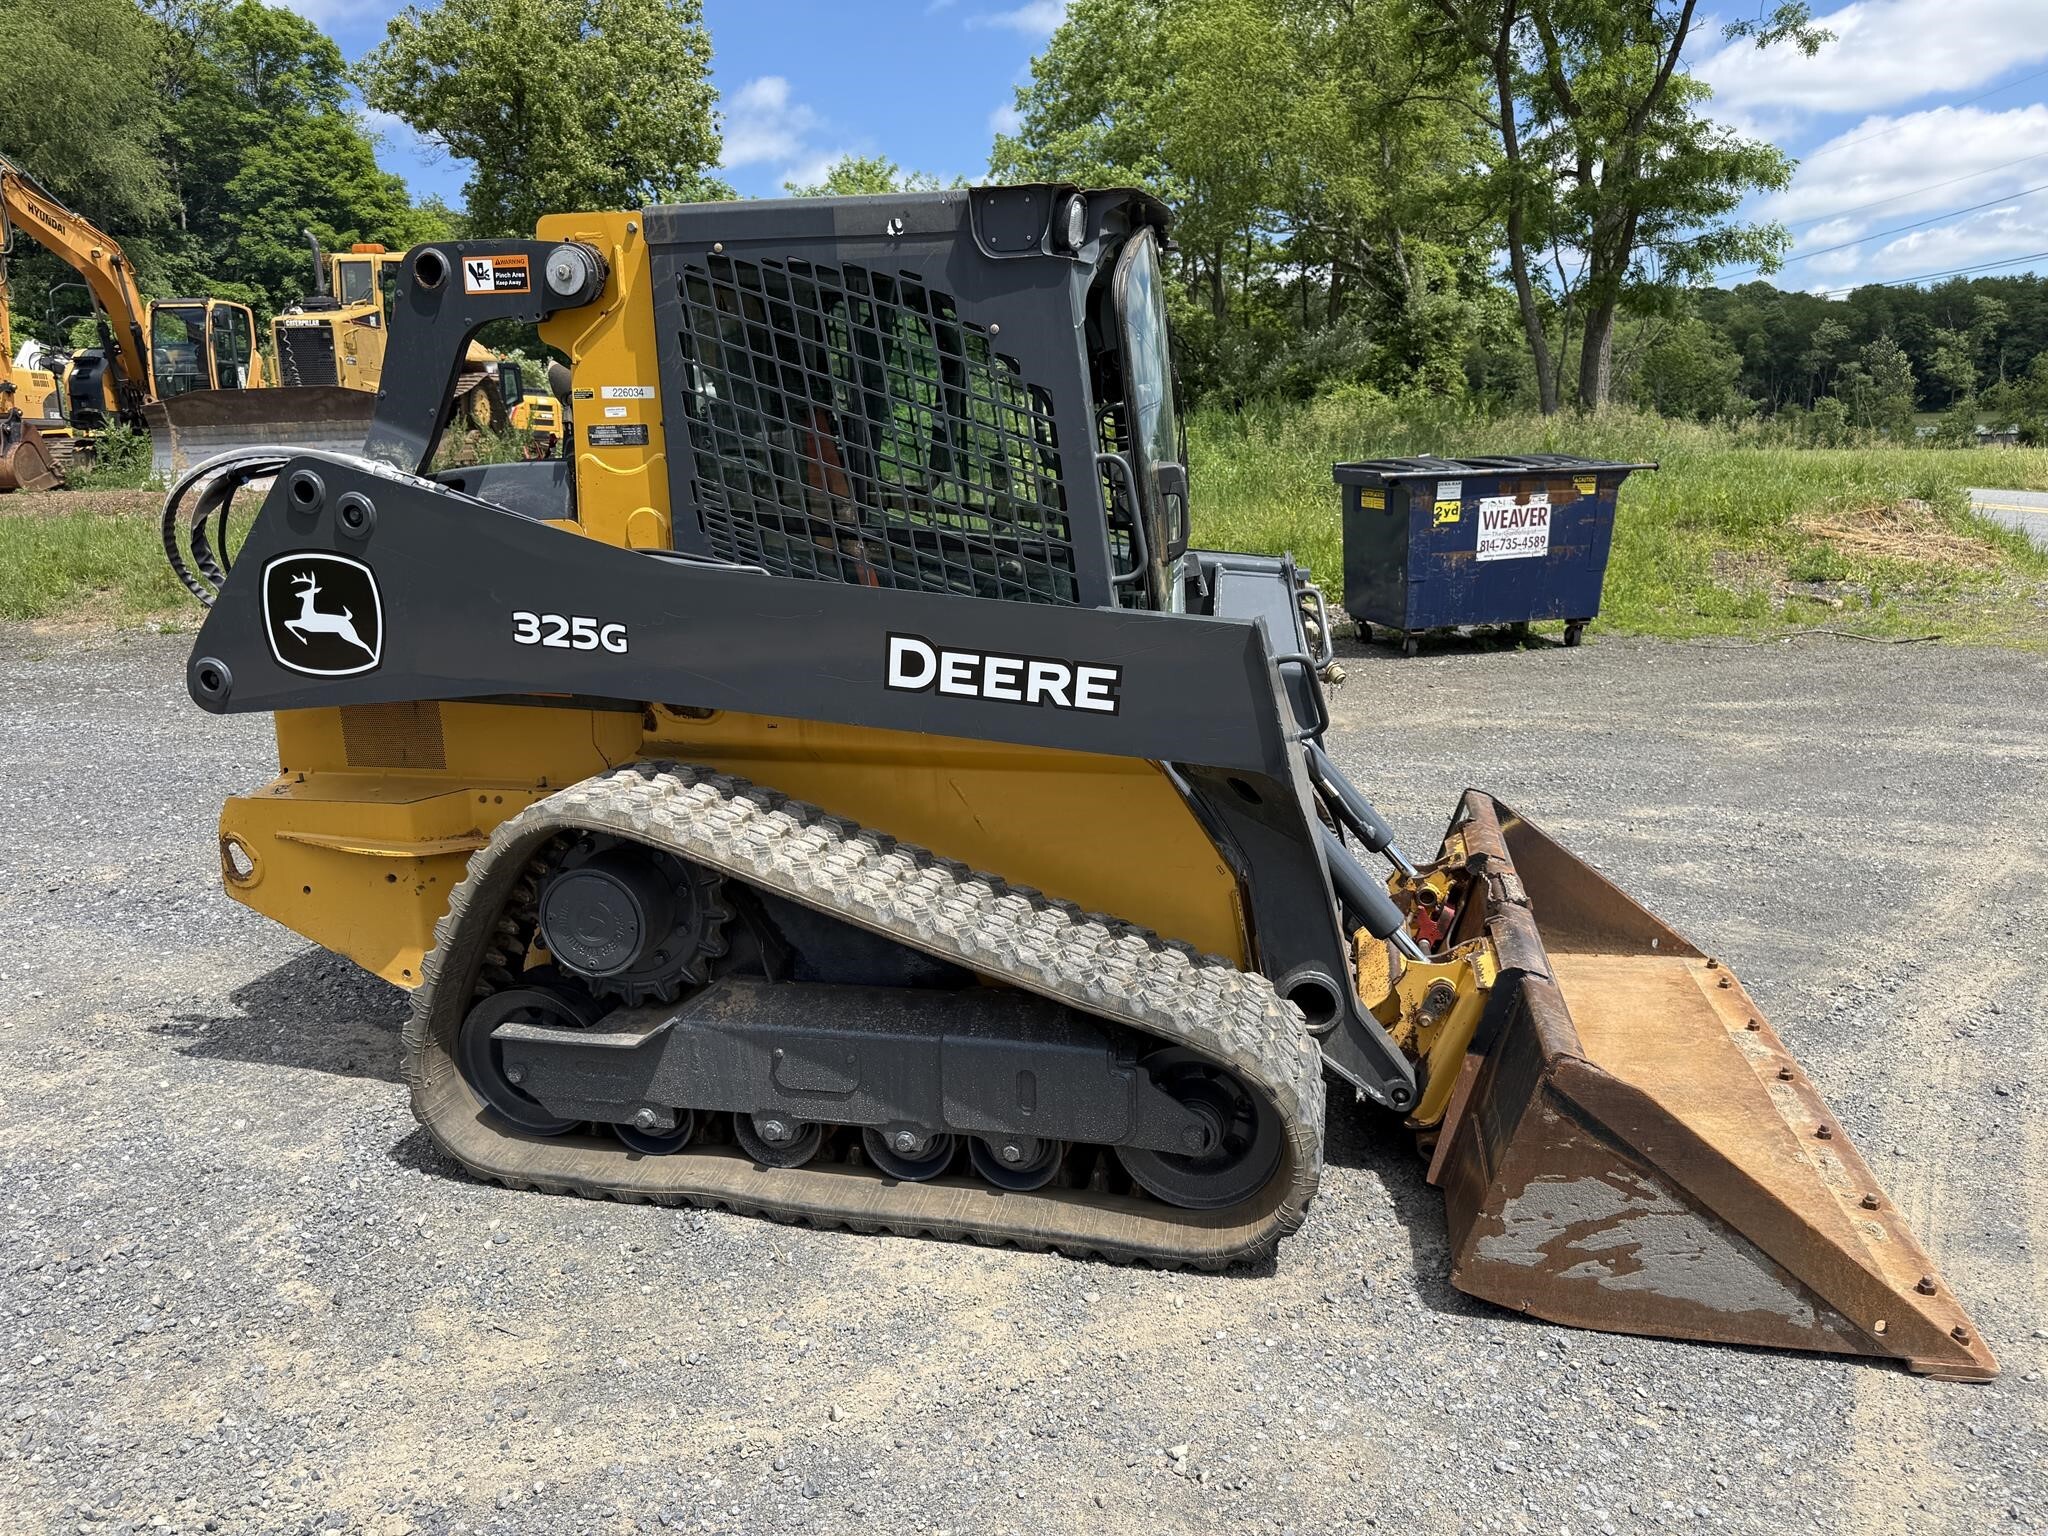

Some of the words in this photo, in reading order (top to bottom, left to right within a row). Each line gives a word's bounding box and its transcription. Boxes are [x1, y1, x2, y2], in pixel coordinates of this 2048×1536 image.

[28, 201, 65, 236] HYUNDAI
[286, 319, 319, 327] CATERPILLAR
[612, 388, 644, 397] 226034
[1483, 507, 1548, 530] WEAVER
[1480, 536, 1546, 552] 814-735-4589
[512, 611, 628, 653] 325G
[888, 637, 1118, 711] DEERE
